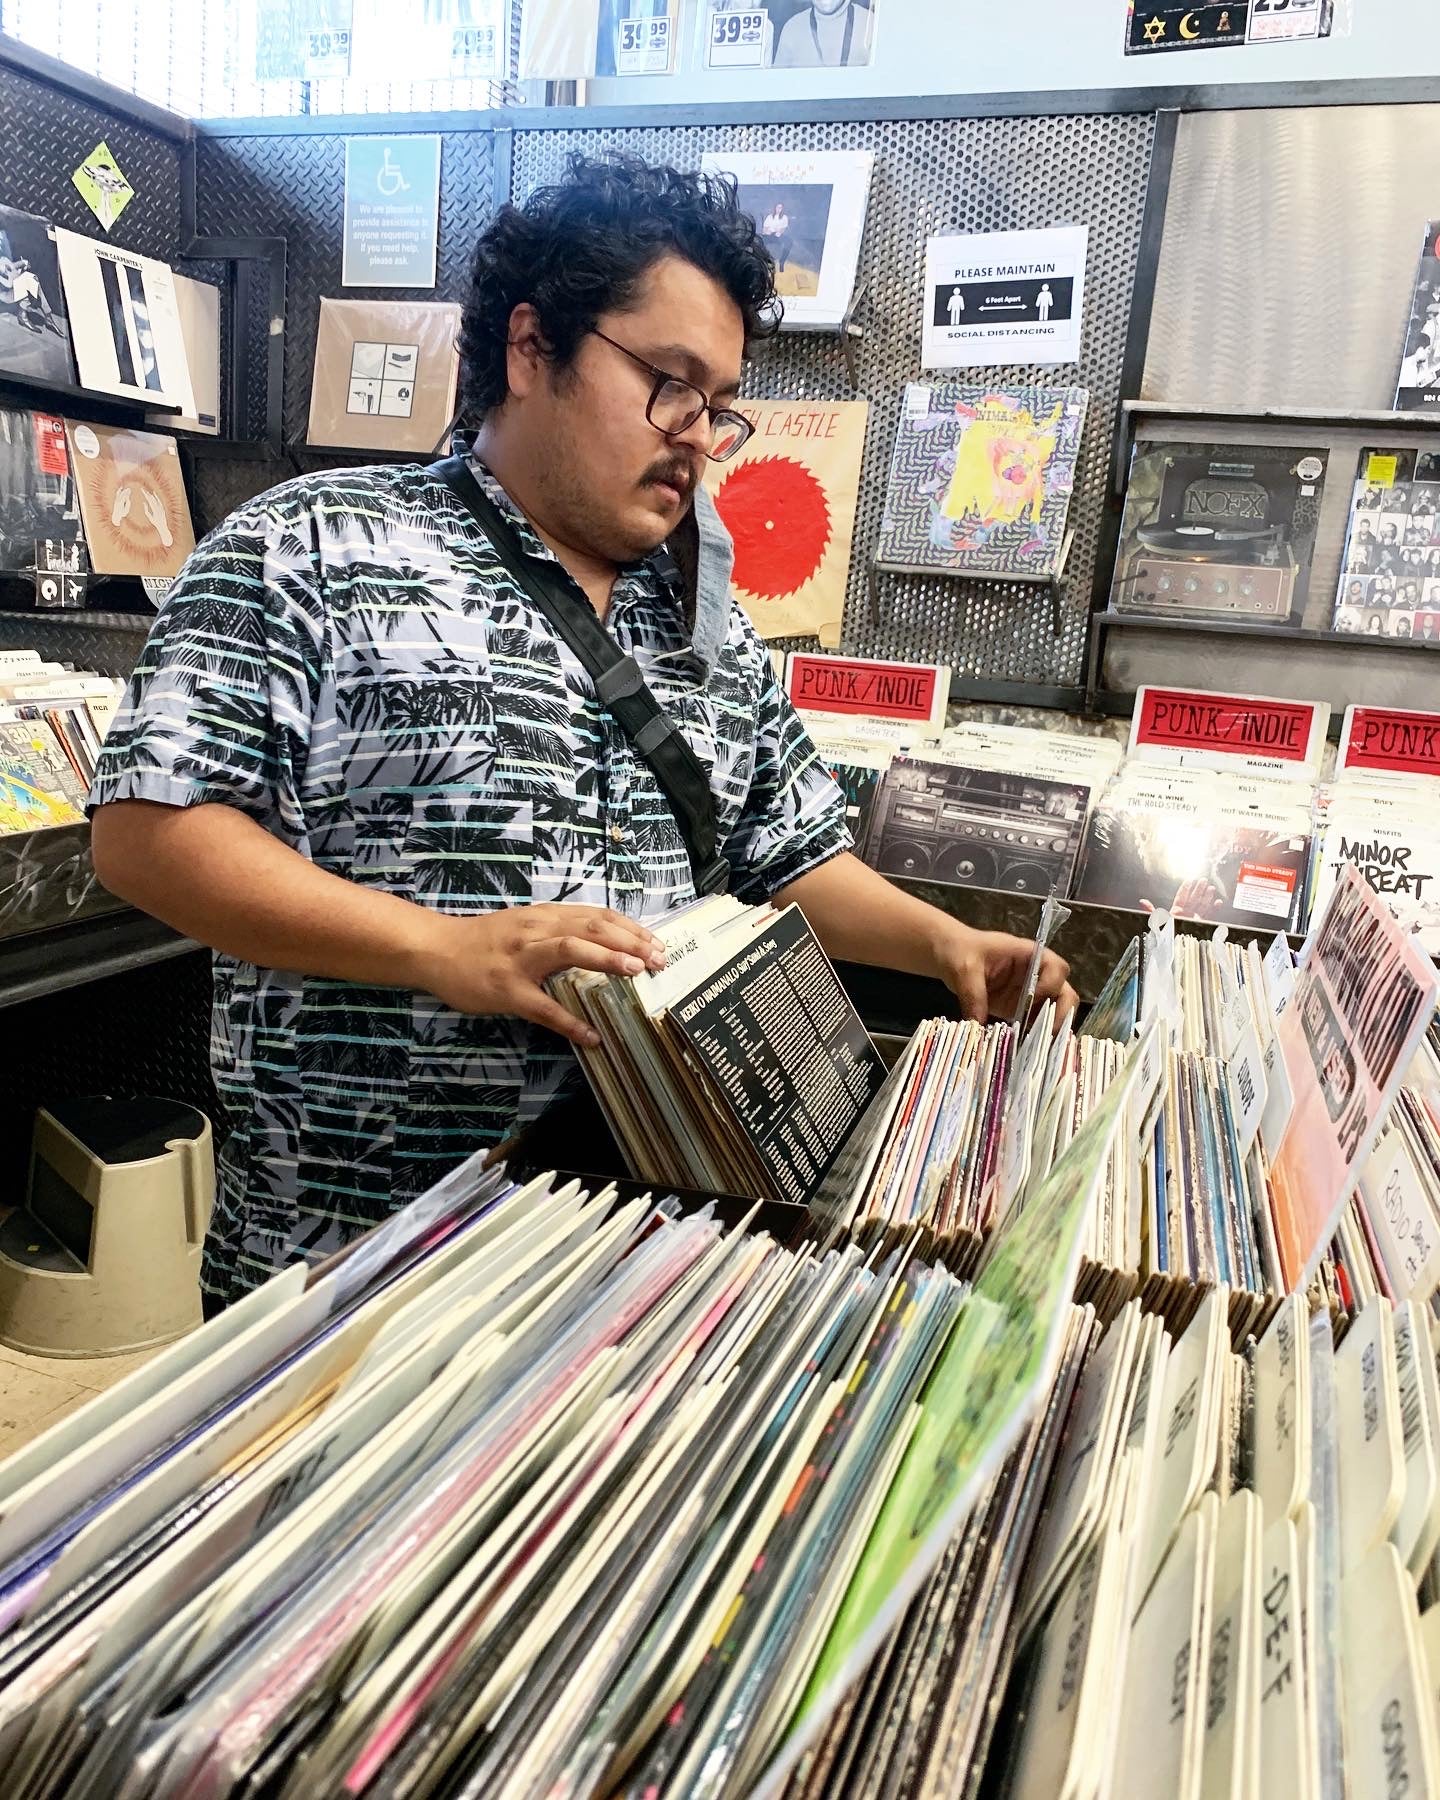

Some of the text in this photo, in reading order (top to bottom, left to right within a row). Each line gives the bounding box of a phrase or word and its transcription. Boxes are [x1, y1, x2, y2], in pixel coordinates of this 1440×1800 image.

[360, 204, 371, 214] We
[385, 204, 414, 216] pleased
[352, 218, 380, 228] provide
[382, 219, 420, 227] assistance
[352, 231, 379, 242] anyone
[381, 231, 419, 242] requesting
[94, 248, 109, 259] JOHN
[360, 242, 366, 253] If
[366, 244, 381, 254] you
[382, 243, 400, 253] need
[369, 256, 393, 267] please
[954, 263, 1056, 279] PLEASE MAINTAIN
[990, 296, 1004, 304] Feet
[1004, 295, 1022, 304] Apart
[947, 327, 1056, 339] SOCIAL DISTANCING
[764, 411, 841, 438] CASTLE
[1184, 489, 1265, 520] NOFX
[799, 667, 929, 708] PUNK/INDIE
[1150, 702, 1304, 747] PUNK/INDIE
[1246, 760, 1284, 770] MAGAZINE
[1137, 791, 1156, 799] IRON
[1128, 797, 1198, 813] THE HOLD STEADY
[1221, 807, 1236, 815] HOT
[1238, 810, 1263, 818] WATER
[1373, 828, 1402, 838] MISFITS
[1339, 836, 1412, 871] MINOR
[1328, 861, 1434, 901] TREAT
[666, 939, 699, 969] SUNNY ADE
[701, 967, 740, 1004] WAIMANALO
[697, 995, 707, 1009] O
[679, 996, 701, 1023] KEIKI
[1305, 988, 1326, 1037] NEW
[1316, 1021, 1330, 1054] &
[1323, 1036, 1351, 1105] USED
